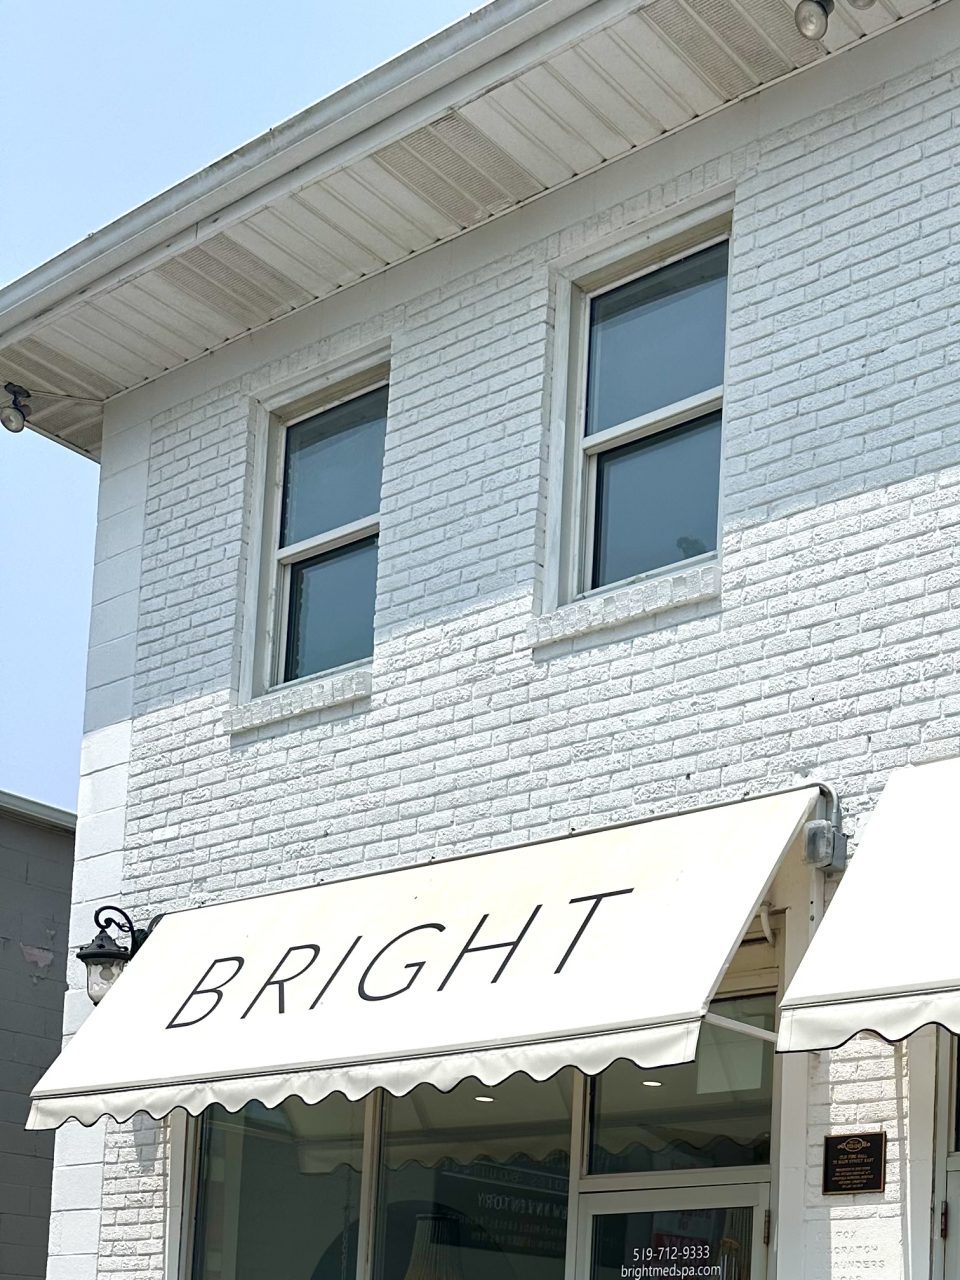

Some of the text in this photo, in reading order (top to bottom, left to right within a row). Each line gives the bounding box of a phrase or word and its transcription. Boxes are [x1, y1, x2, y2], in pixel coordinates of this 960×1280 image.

[165, 887, 635, 1029] BRIGHT
[633, 1245, 710, 1261] 519-712-9333
[621, 1263, 721, 1280] brightmedspa.com
